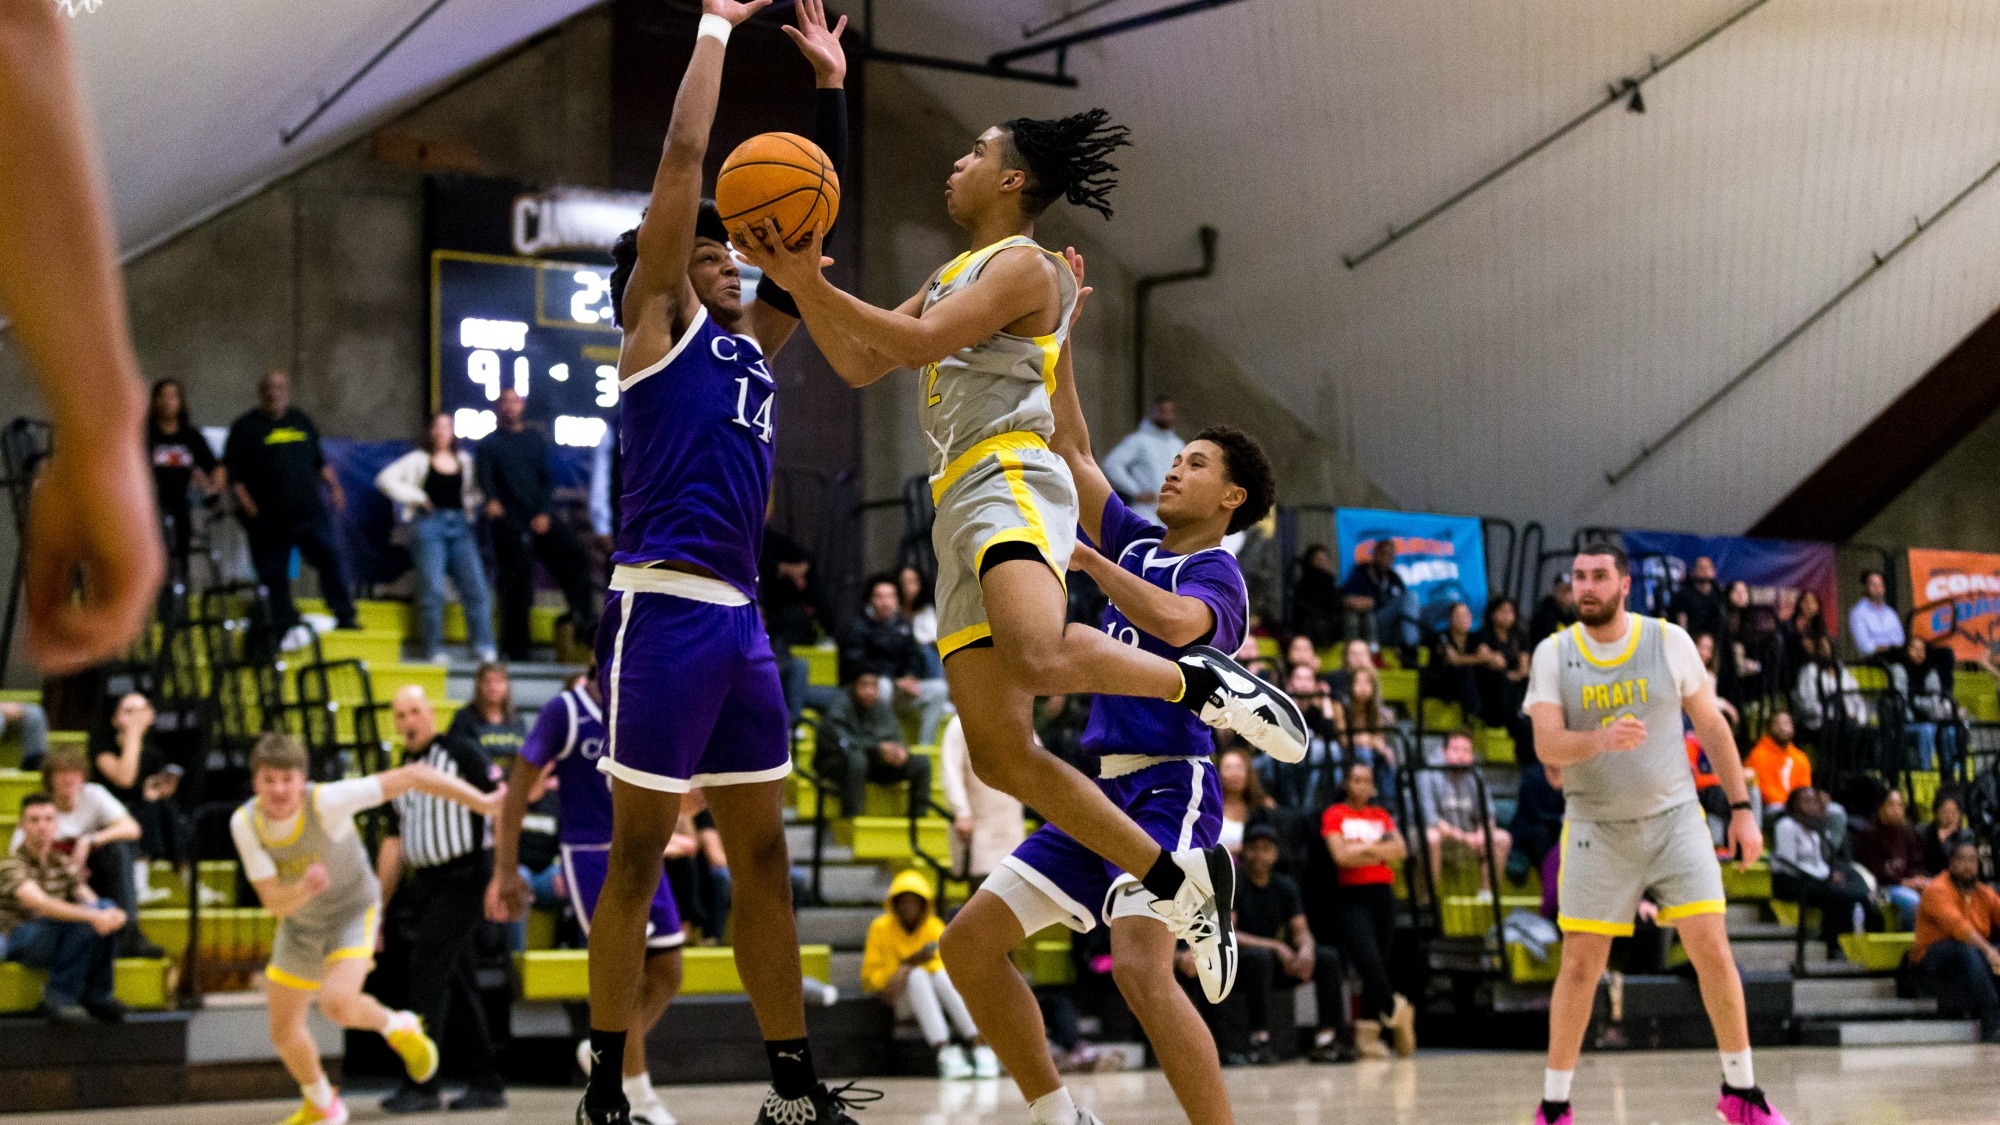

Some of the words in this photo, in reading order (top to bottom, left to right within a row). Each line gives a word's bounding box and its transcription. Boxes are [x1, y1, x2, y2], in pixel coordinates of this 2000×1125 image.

[468, 350, 530, 401] 91
[731, 376, 775, 444] 14
[1581, 678, 1648, 711] PRATT
